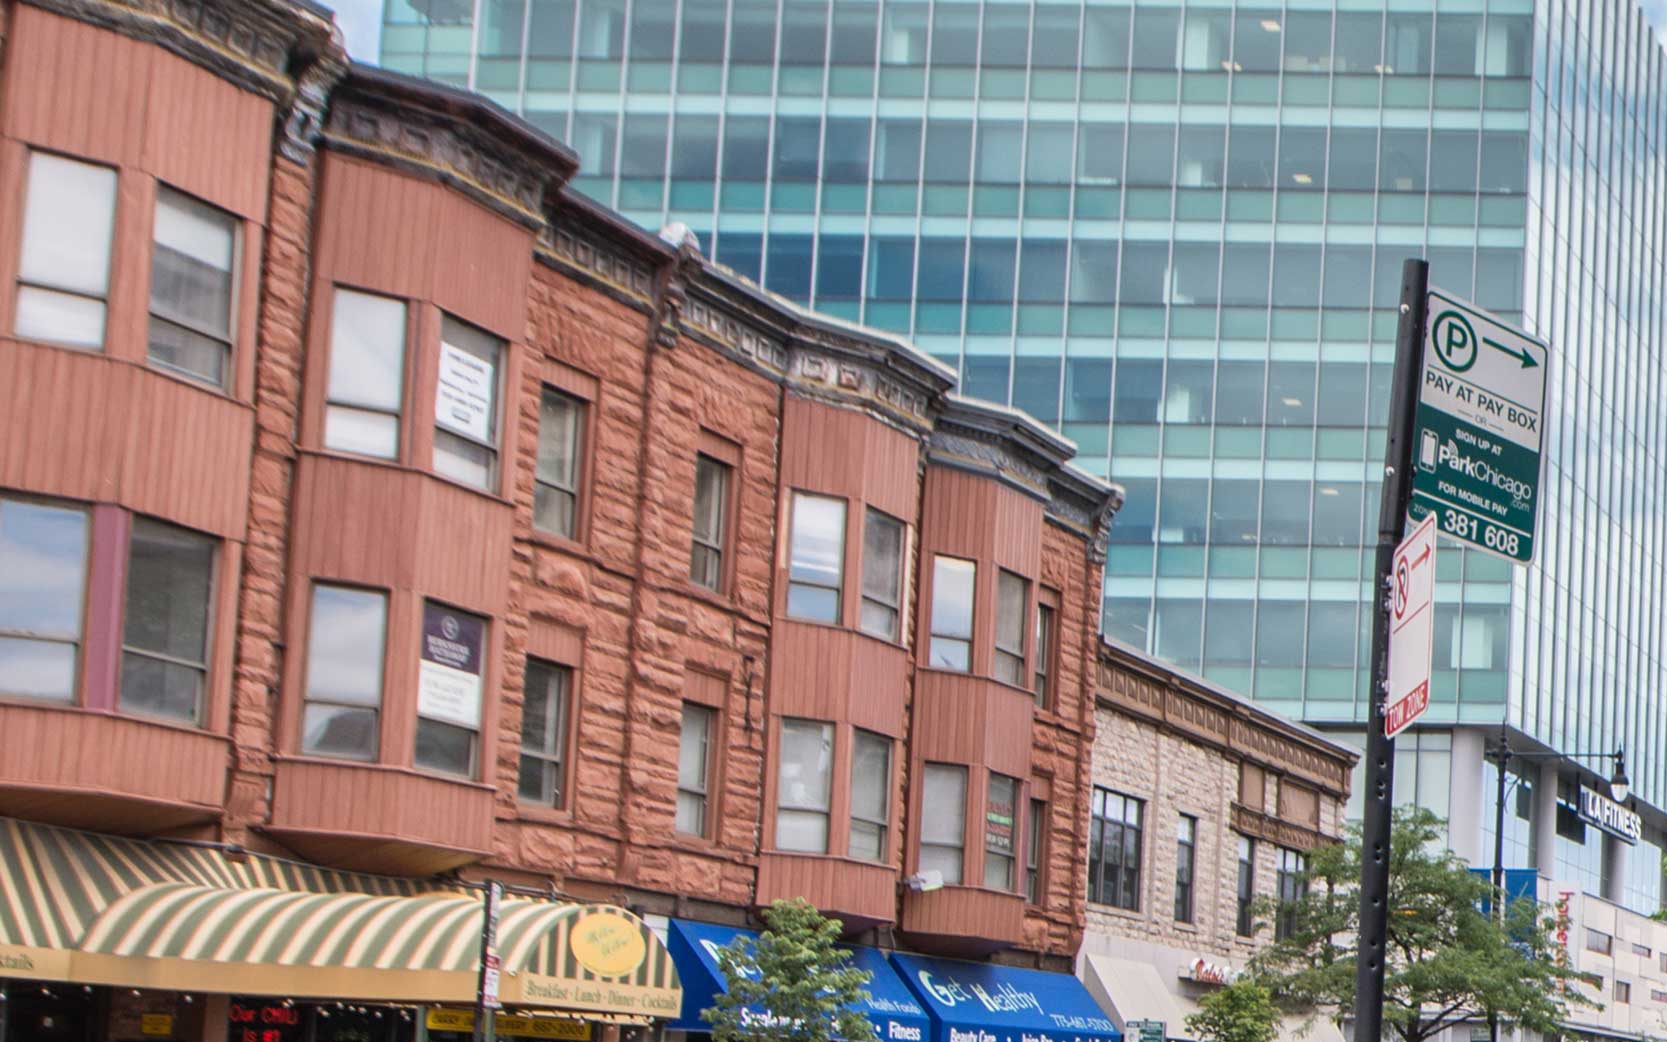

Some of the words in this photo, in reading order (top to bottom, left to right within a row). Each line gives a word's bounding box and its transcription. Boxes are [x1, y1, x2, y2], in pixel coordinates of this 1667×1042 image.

[1446, 320, 1468, 357] P
[1426, 370, 1454, 394] PAY
[1455, 385, 1474, 404] AT
[1477, 394, 1505, 418] PAY
[1508, 408, 1537, 433] BOX
[1474, 413, 1488, 427] OR
[1455, 428, 1477, 445] SIGN
[1478, 439, 1490, 450] UP
[1491, 445, 1503, 456] AT
[1438, 444, 1532, 500] ParkChicago
[1438, 481, 1457, 496] FOR
[1458, 488, 1491, 510] MOBILE
[1492, 501, 1508, 516] PAY
[1444, 509, 1478, 540] 381
[1484, 525, 1519, 556] 608
[1388, 702, 1403, 730] TOW
[1405, 686, 1426, 718] ZONE
[1588, 791, 1602, 821] LA
[1604, 799, 1642, 841] FITNESS
[527, 980, 568, 999] Breakfast
[575, 985, 601, 1004] Lunch
[608, 989, 635, 1007] Dinner
[641, 992, 677, 1010] Cocktails
[918, 969, 972, 1008] Get
[969, 982, 1034, 1017] Healthy
[229, 1003, 256, 1022] Our
[888, 1020, 921, 1041] Fitness
